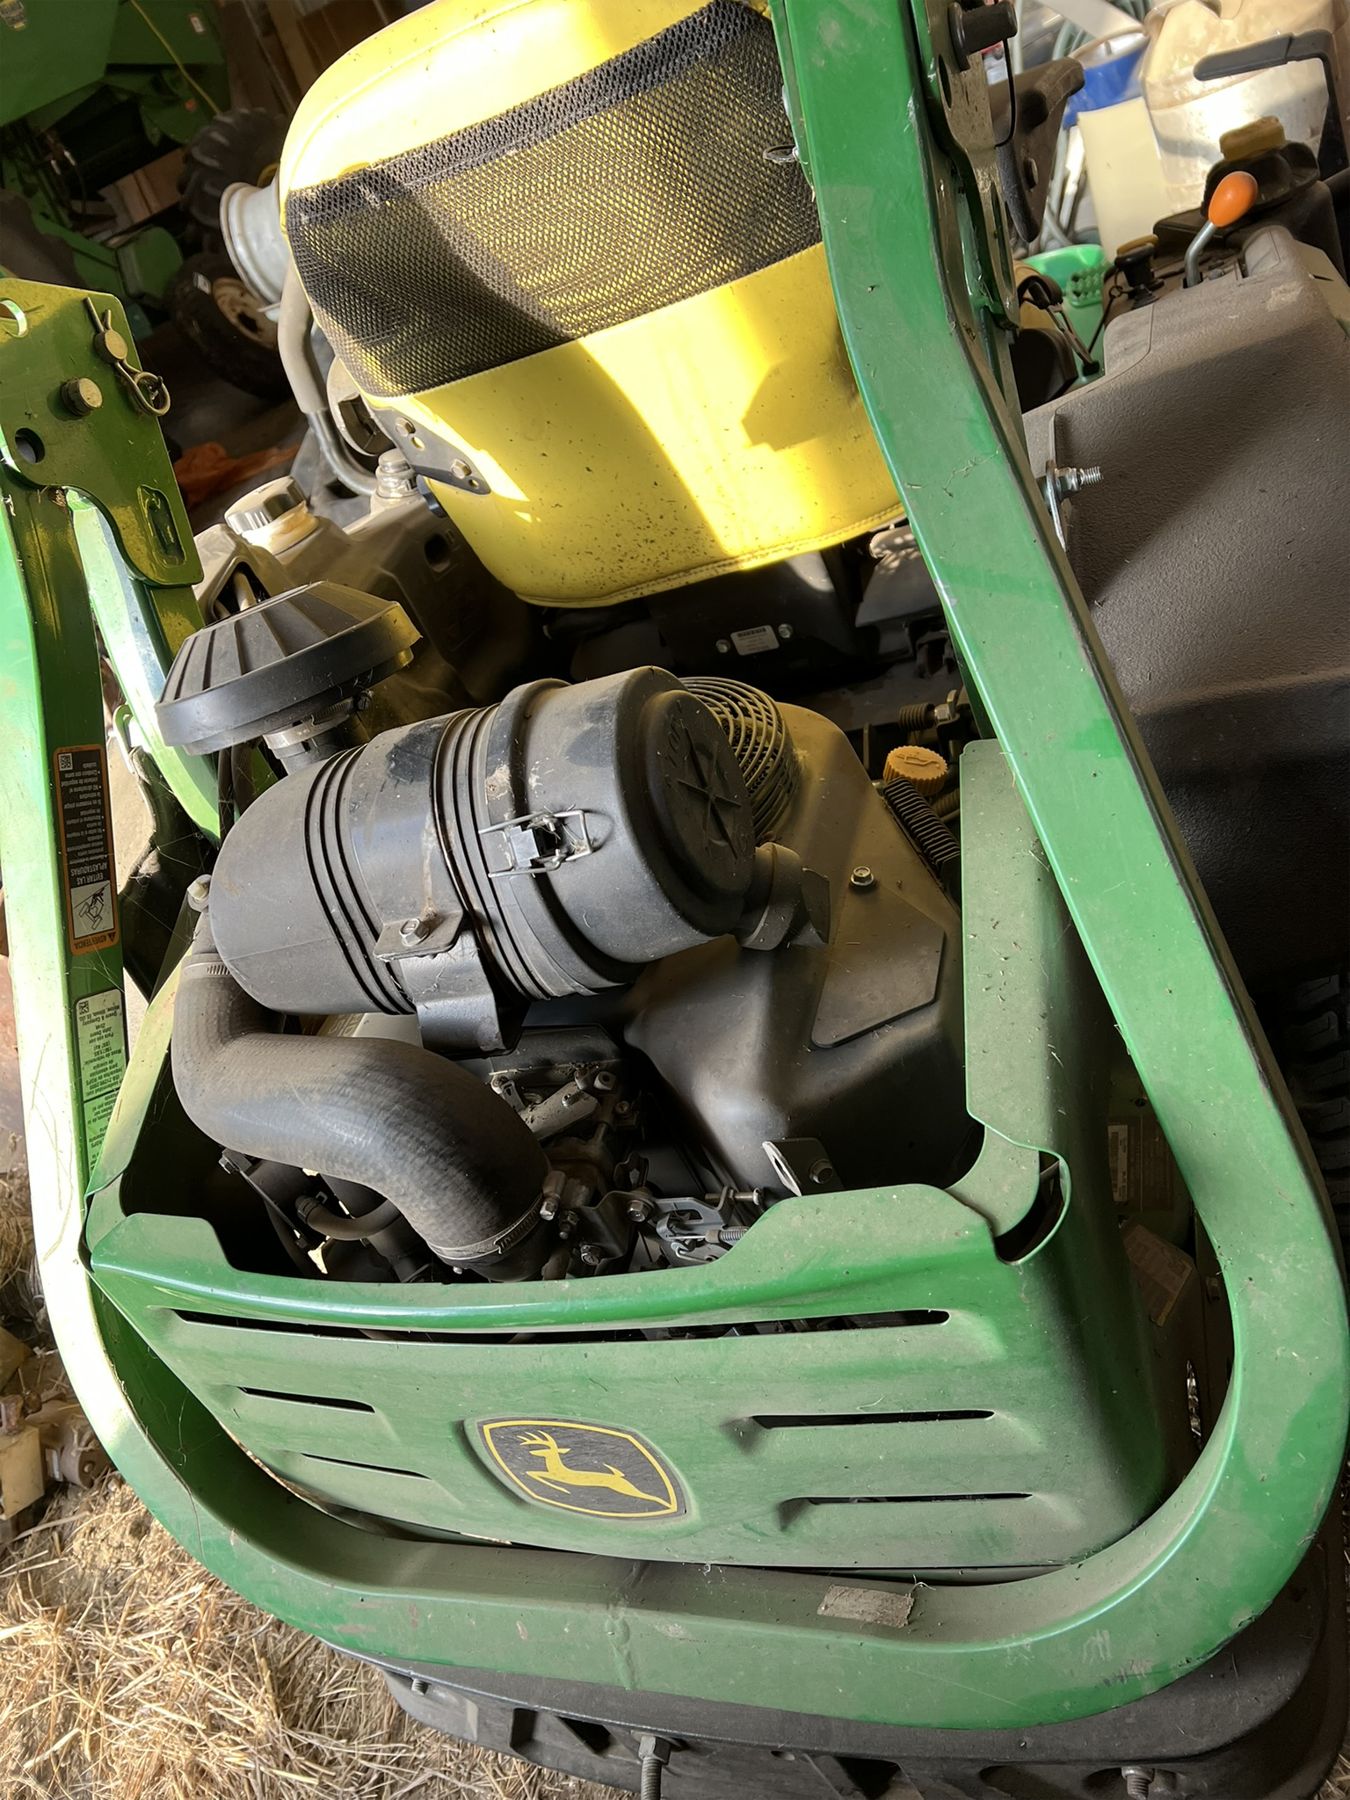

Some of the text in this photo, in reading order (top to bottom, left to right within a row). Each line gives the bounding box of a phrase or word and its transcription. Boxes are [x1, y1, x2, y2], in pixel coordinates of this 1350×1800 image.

[71, 862, 108, 876] APLASTADURAS
[76, 872, 103, 885] EVITAR LAS
